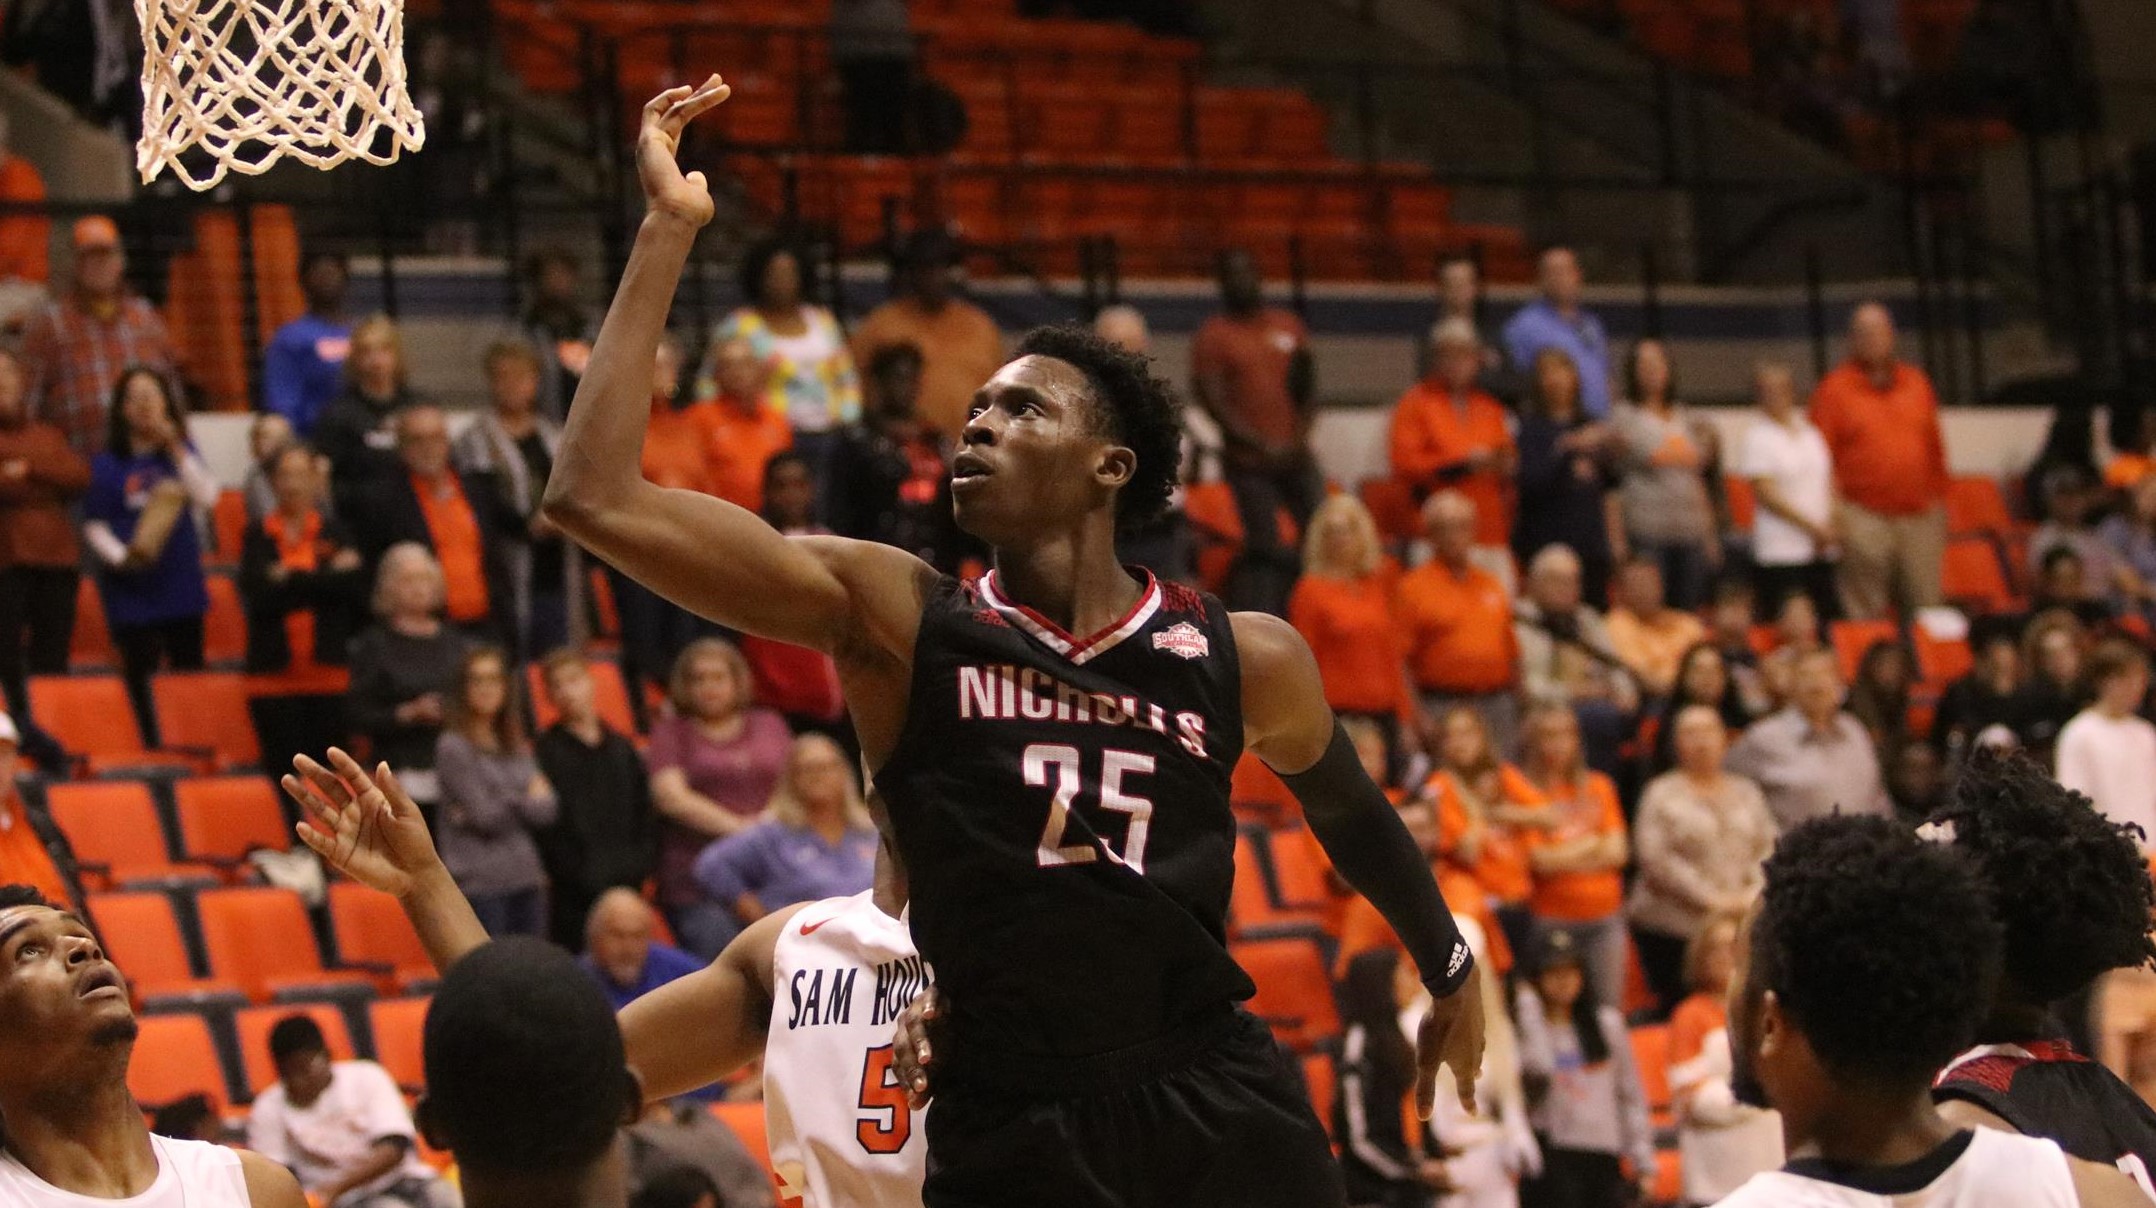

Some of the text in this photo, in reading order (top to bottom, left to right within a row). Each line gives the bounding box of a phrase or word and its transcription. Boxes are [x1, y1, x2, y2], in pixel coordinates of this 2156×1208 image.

[1153, 632, 1208, 655] SOUTHLA
[1021, 743, 1156, 876] 25
[788, 967, 858, 1030] SAM
[856, 1043, 911, 1154] 5
